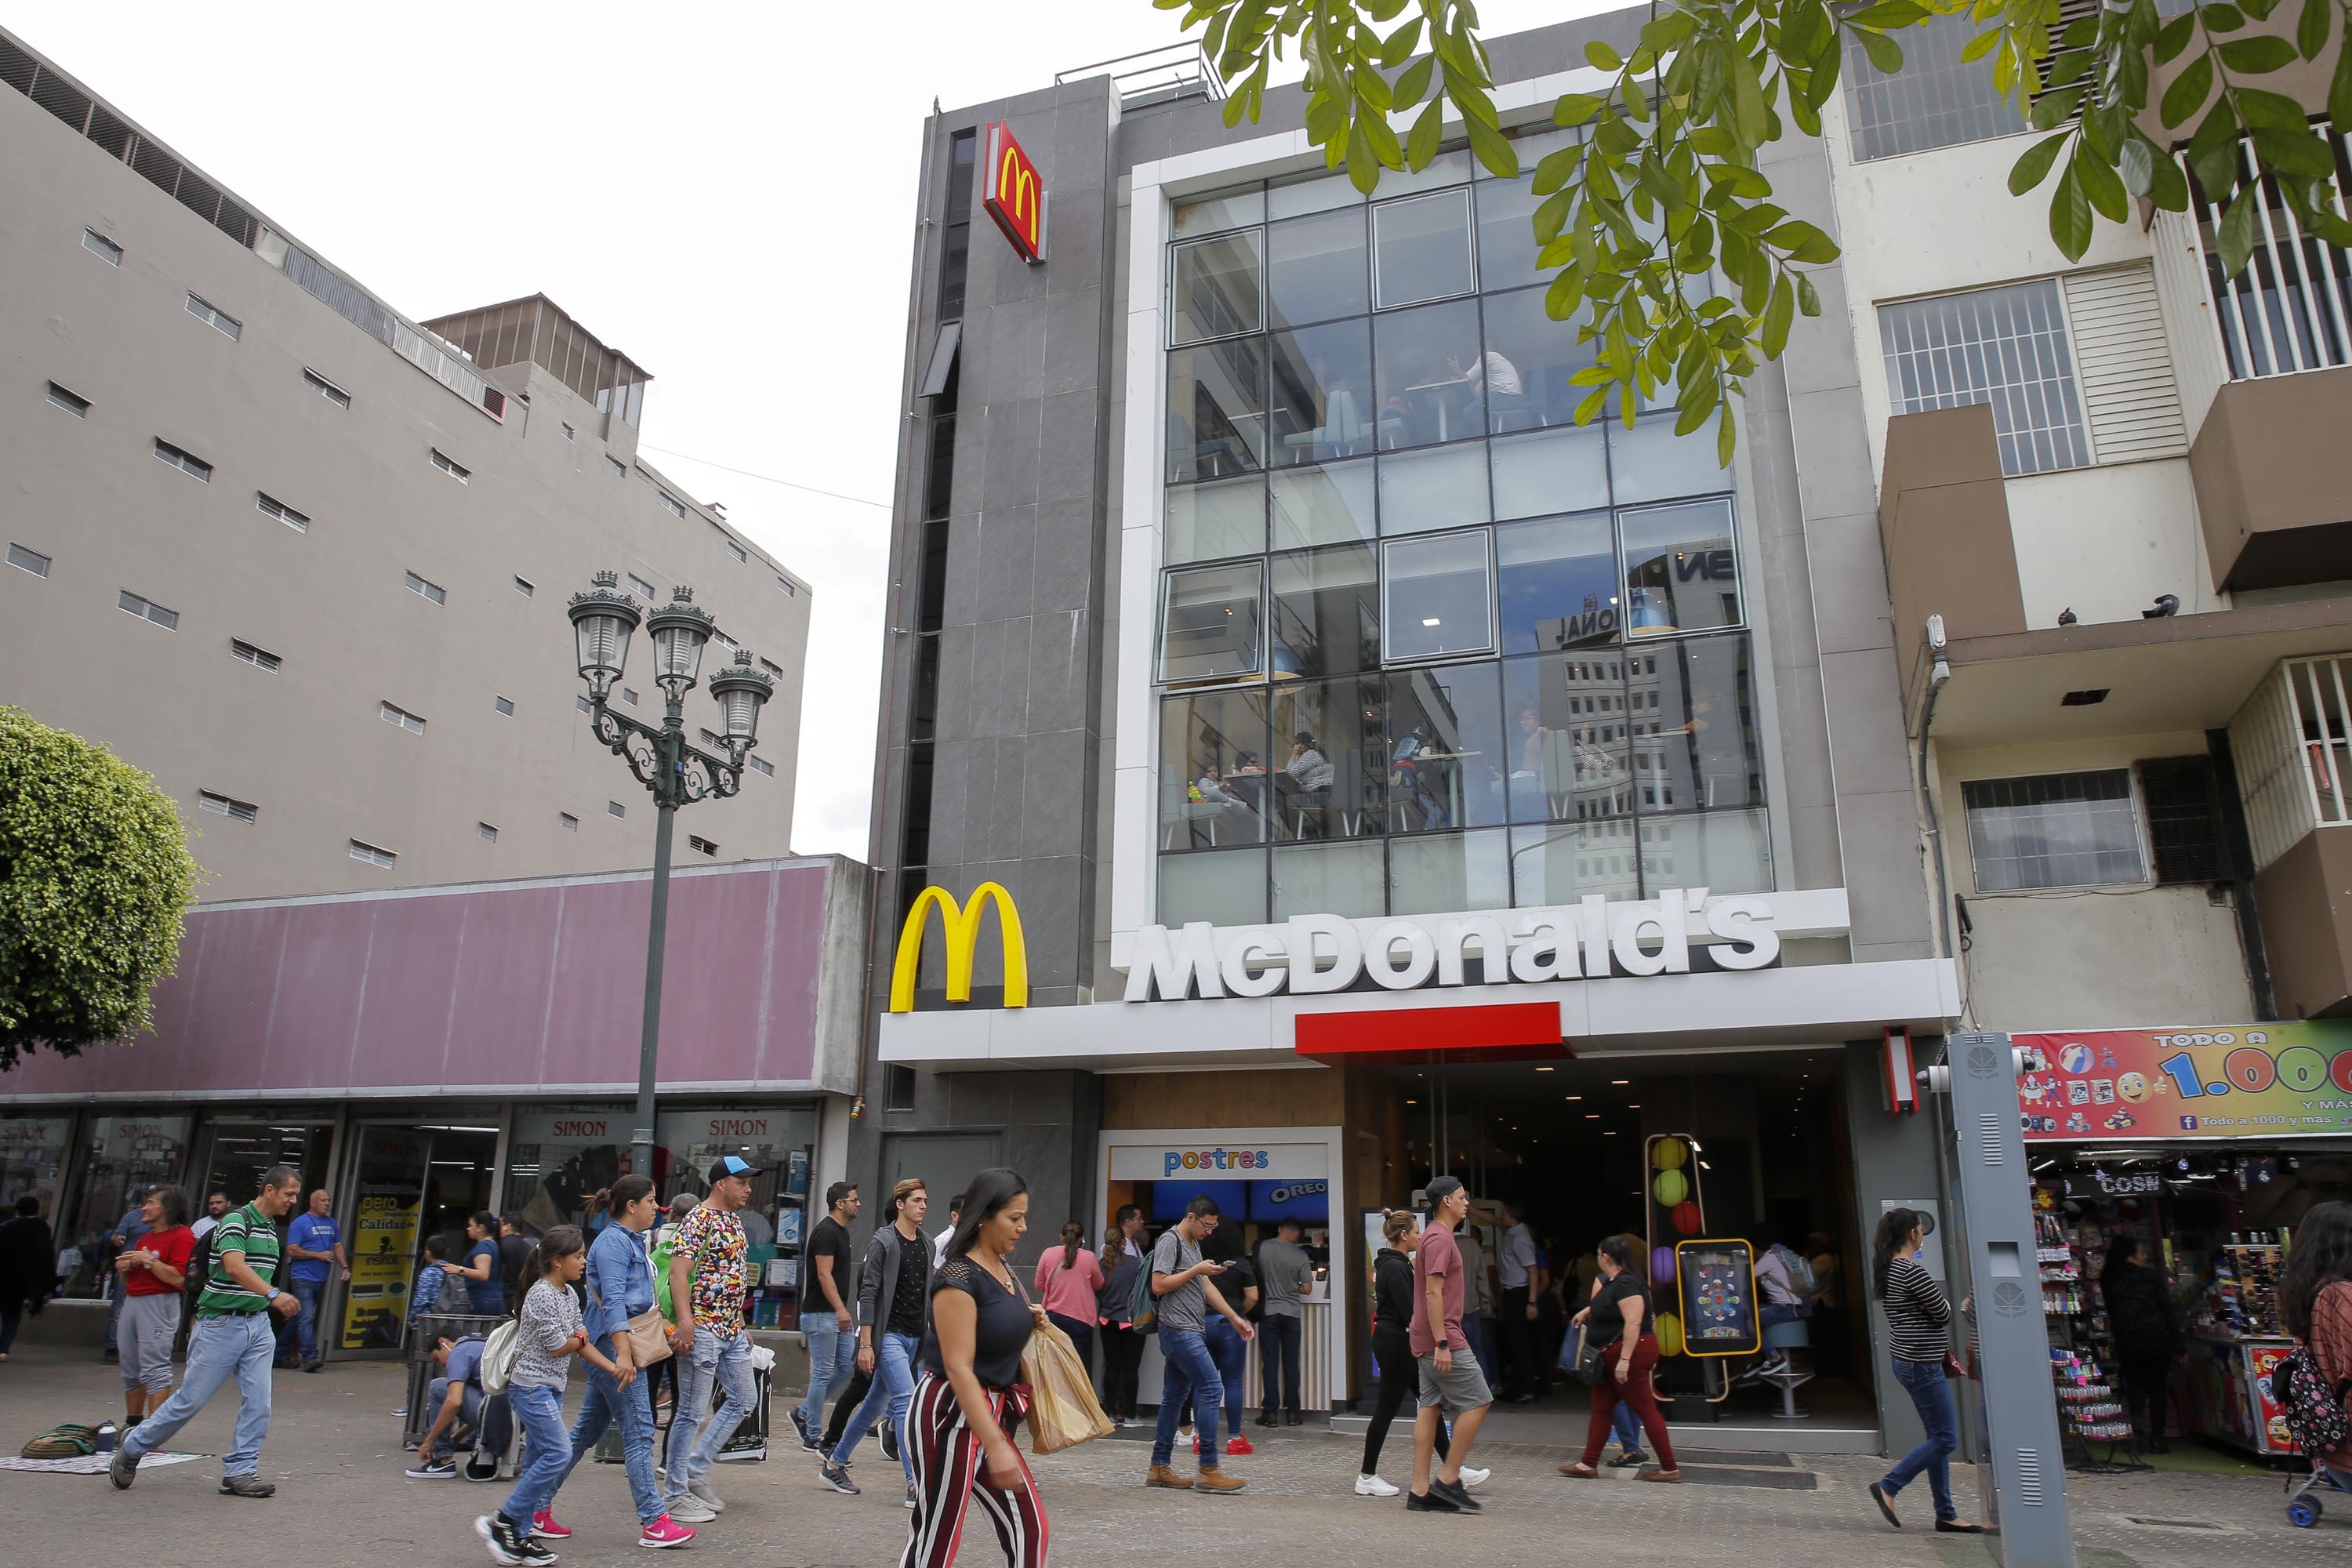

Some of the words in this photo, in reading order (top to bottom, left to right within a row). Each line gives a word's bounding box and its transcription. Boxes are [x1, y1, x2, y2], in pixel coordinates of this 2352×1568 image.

[1124, 887, 1781, 1004] McDonald's
[2153, 1032, 2237, 1047] TODO
[2245, 1031, 2268, 1044] A
[2301, 1100, 2314, 1109] Y
[710, 1120, 768, 1135] SIMON
[2201, 1116, 2234, 1126] Todo
[2251, 1116, 2285, 1125] 1000
[2288, 1117, 2297, 1126] y
[119, 1124, 162, 1138] SIMON
[553, 1121, 607, 1137] SIMON
[1164, 1148, 1269, 1177] postres
[1269, 1181, 1327, 1203] OREO
[359, 1218, 407, 1230] Calidad
